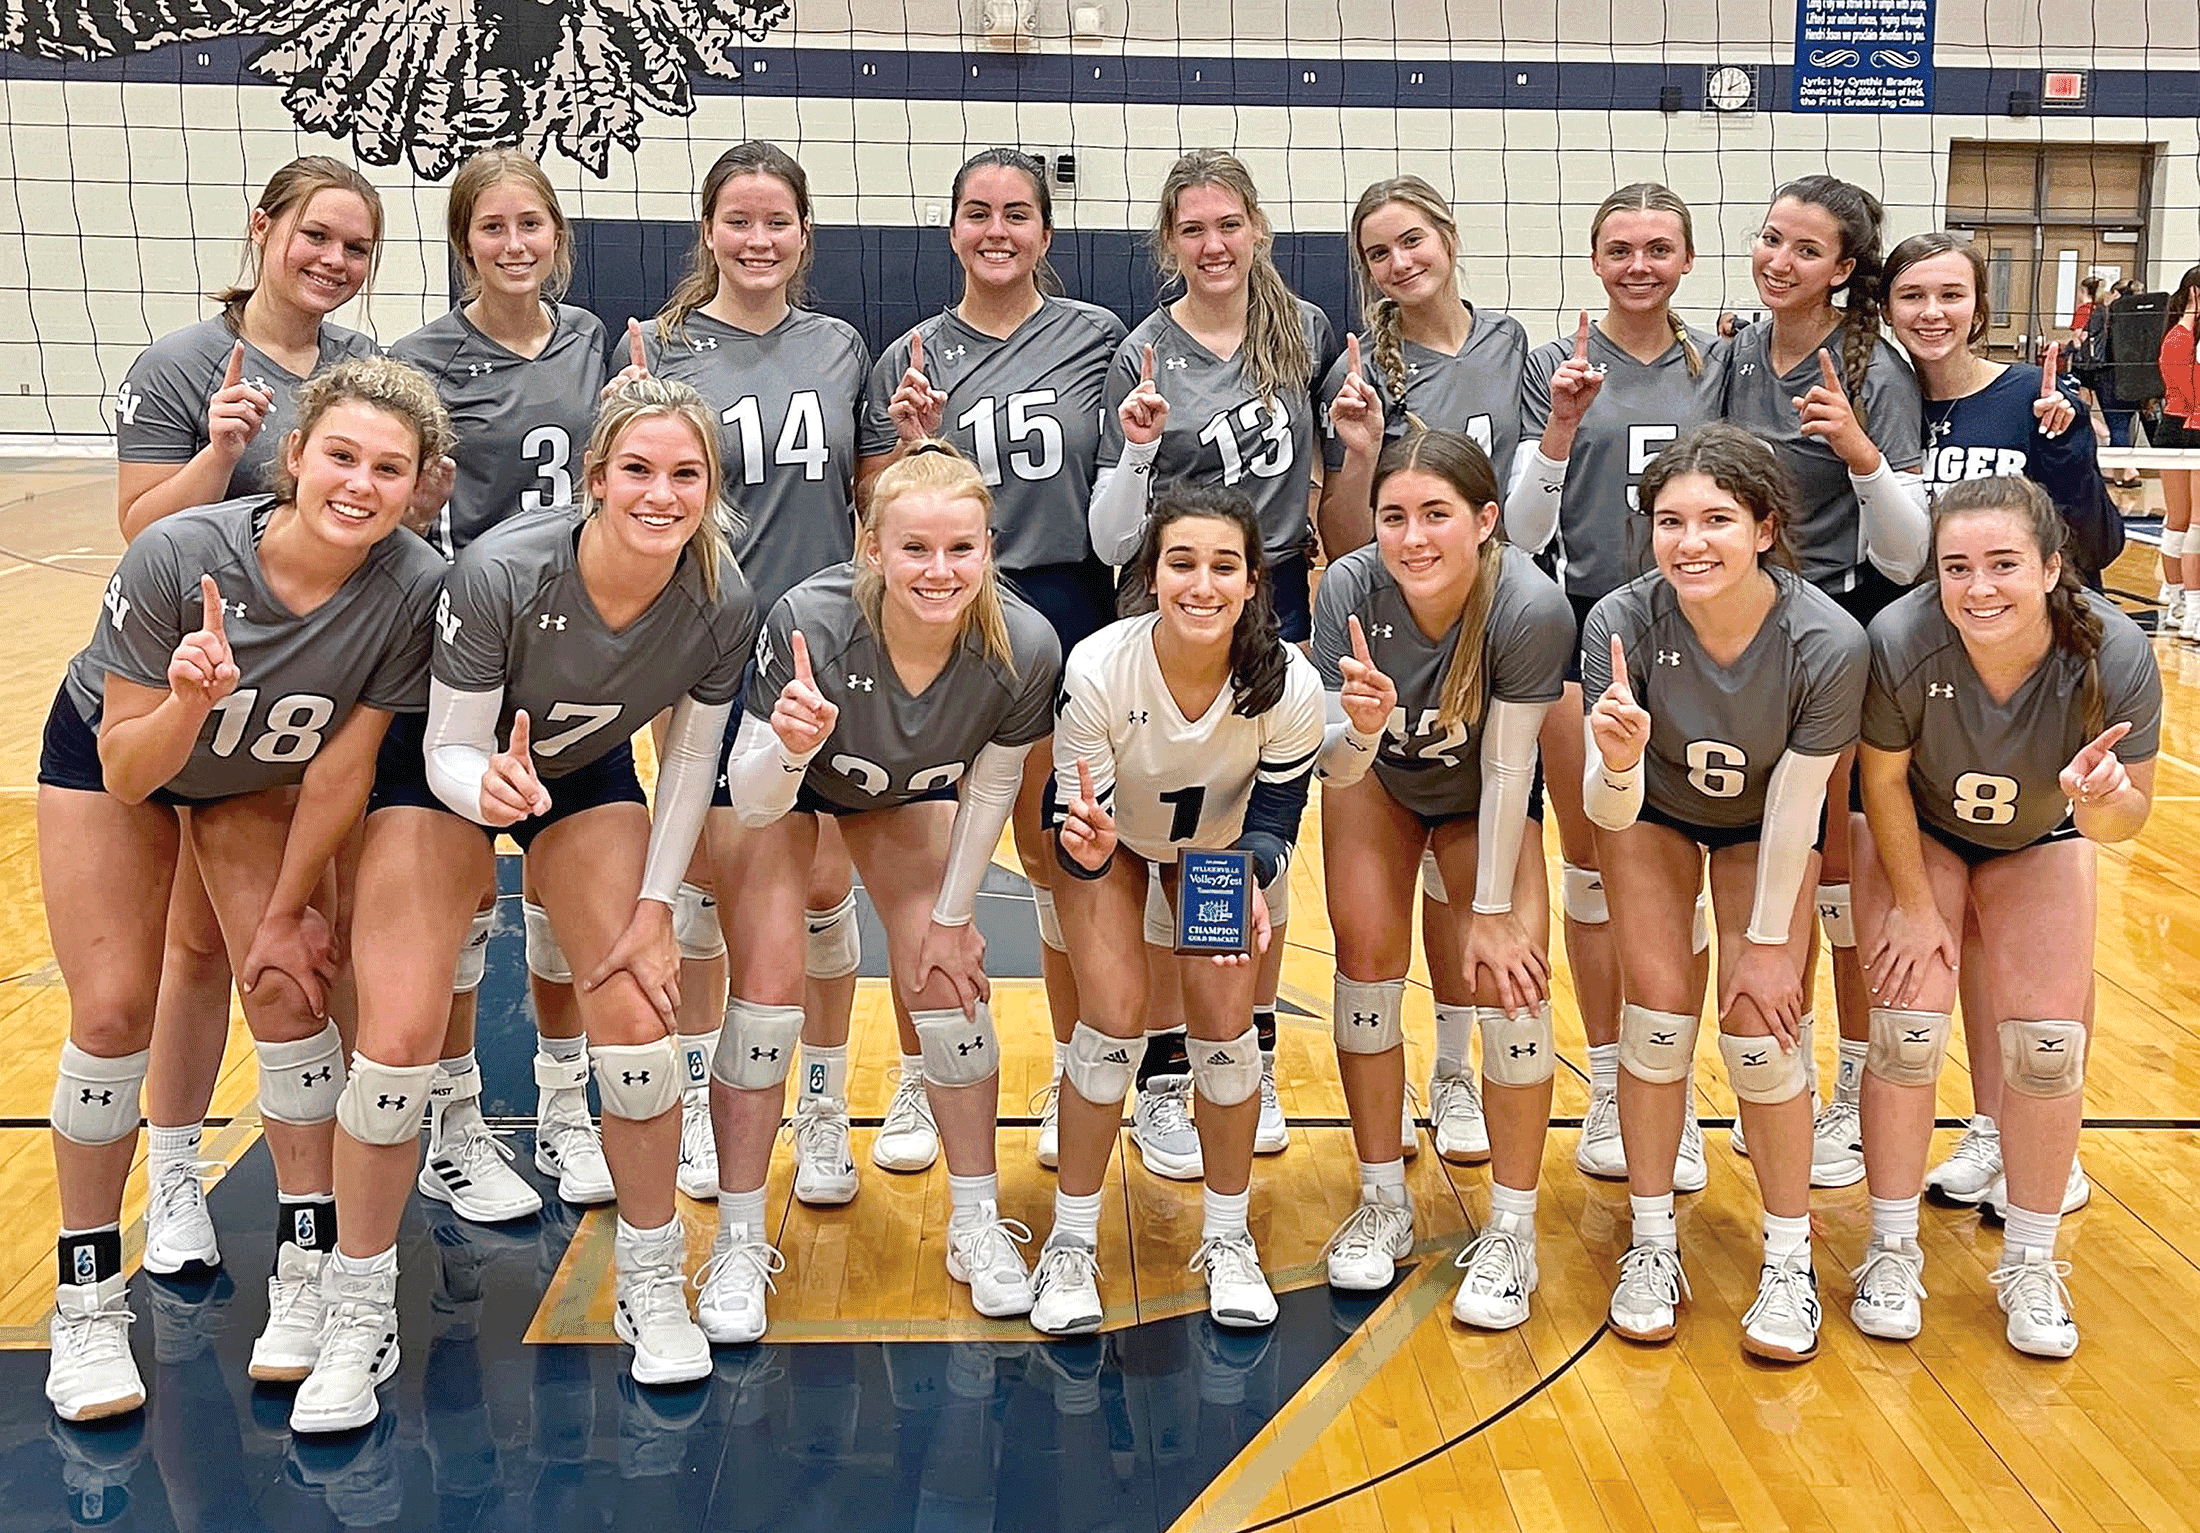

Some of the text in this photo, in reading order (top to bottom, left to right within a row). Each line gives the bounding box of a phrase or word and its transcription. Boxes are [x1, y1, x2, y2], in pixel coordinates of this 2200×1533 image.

[1805, 27, 1842, 41] Hendrikson
[1905, 30, 1912, 41] to
[1872, 0, 1896, 12] trumph
[1800, 86, 1832, 96] Donated
[1832, 87, 1843, 97] by
[1843, 87, 1858, 96] the
[1857, 87, 1877, 97] 2006
[1897, 86, 1907, 97] of
[1800, 97, 1817, 107] the
[1818, 97, 1842, 107] Frst
[1898, 98, 1925, 108] Class
[1803, 76, 1924, 88] Lyrics by Cynthia Bradley
[720, 389, 831, 486] 14
[957, 388, 1066, 487] 15
[1197, 395, 1296, 488] 13
[520, 424, 573, 512] 3
[210, 686, 336, 763] 18
[531, 701, 625, 758] 7
[1387, 704, 1468, 768] 12
[1685, 738, 1748, 799] 6
[1159, 786, 1206, 843] 1
[1952, 770, 2020, 826] 8
[1188, 925, 1239, 935] CHAMPION
